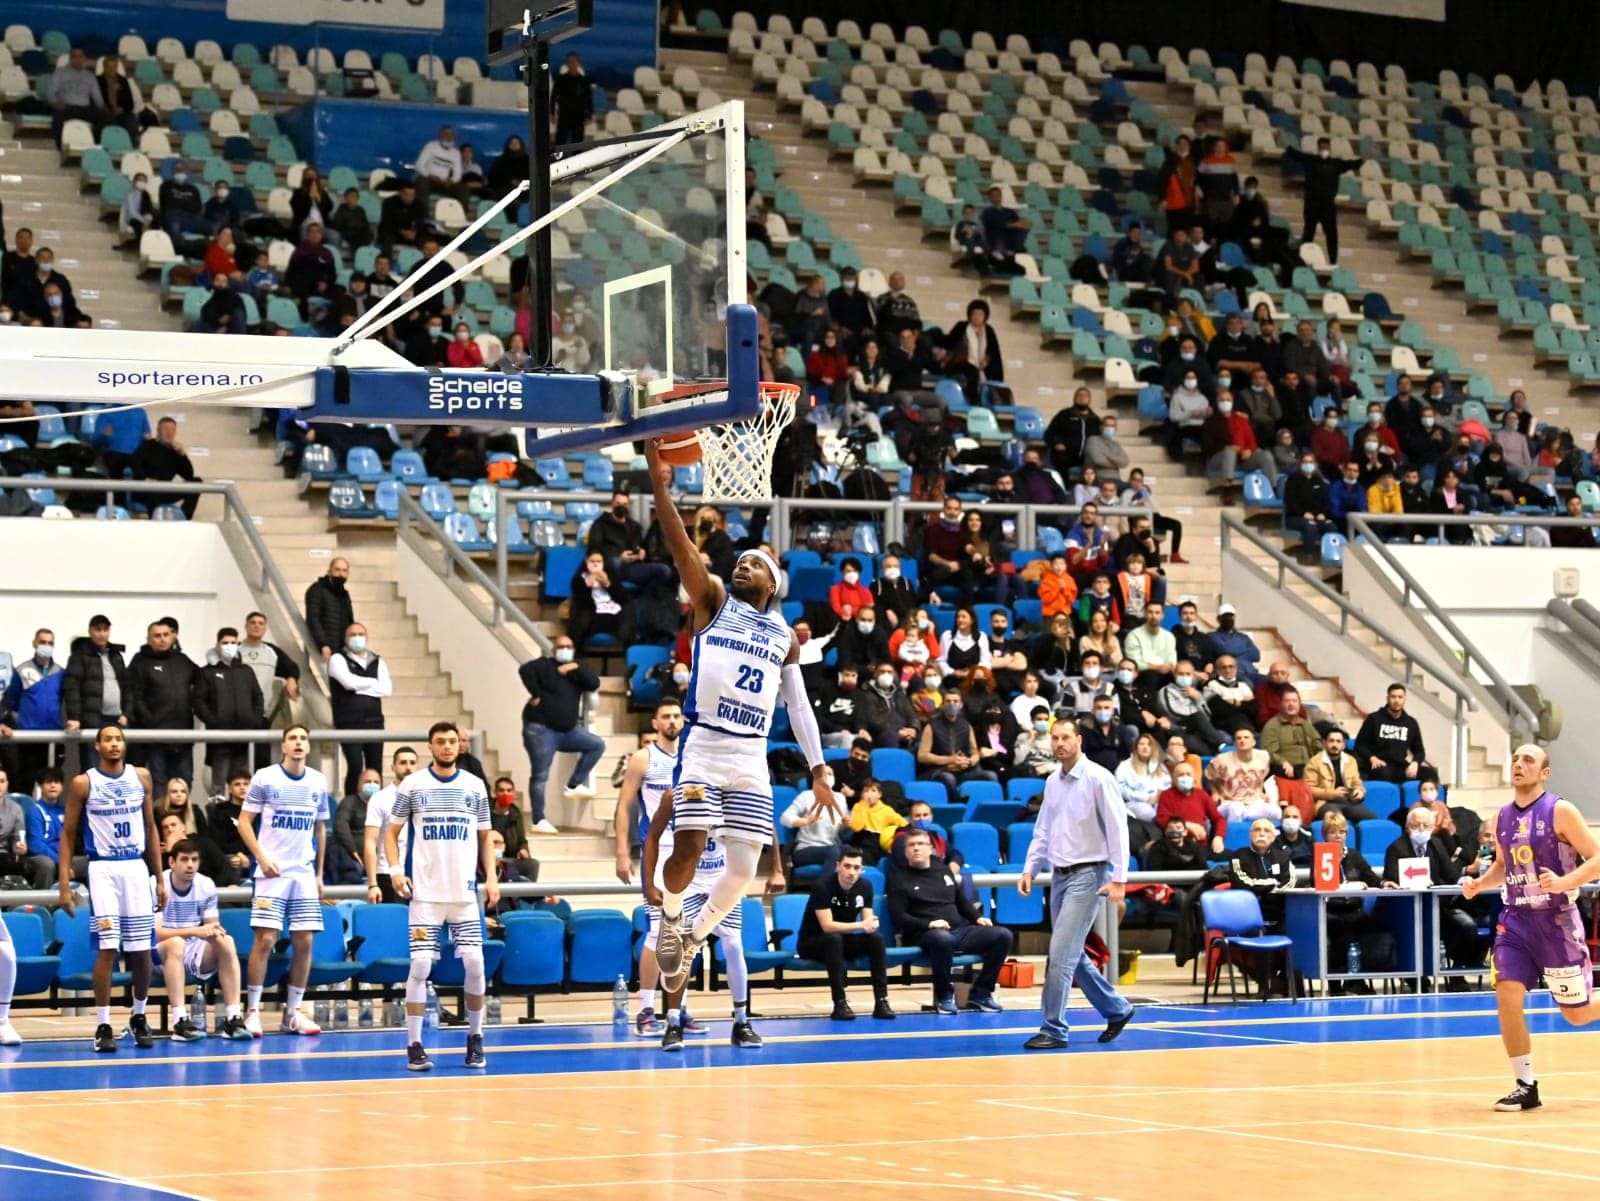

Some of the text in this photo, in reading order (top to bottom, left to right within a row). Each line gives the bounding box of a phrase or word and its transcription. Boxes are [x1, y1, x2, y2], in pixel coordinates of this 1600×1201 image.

[98, 370, 263, 388] sportarena.ro
[429, 377, 523, 394] Schelde
[429, 393, 523, 414] Sports
[706, 635, 769, 659] UNIVERSITATEA
[750, 631, 769, 646] SCM
[735, 664, 764, 694] 23
[717, 702, 766, 732] CRAIOVA
[113, 821, 131, 839] 30
[1510, 845, 1534, 866] 10
[1321, 852, 1334, 882] 5
